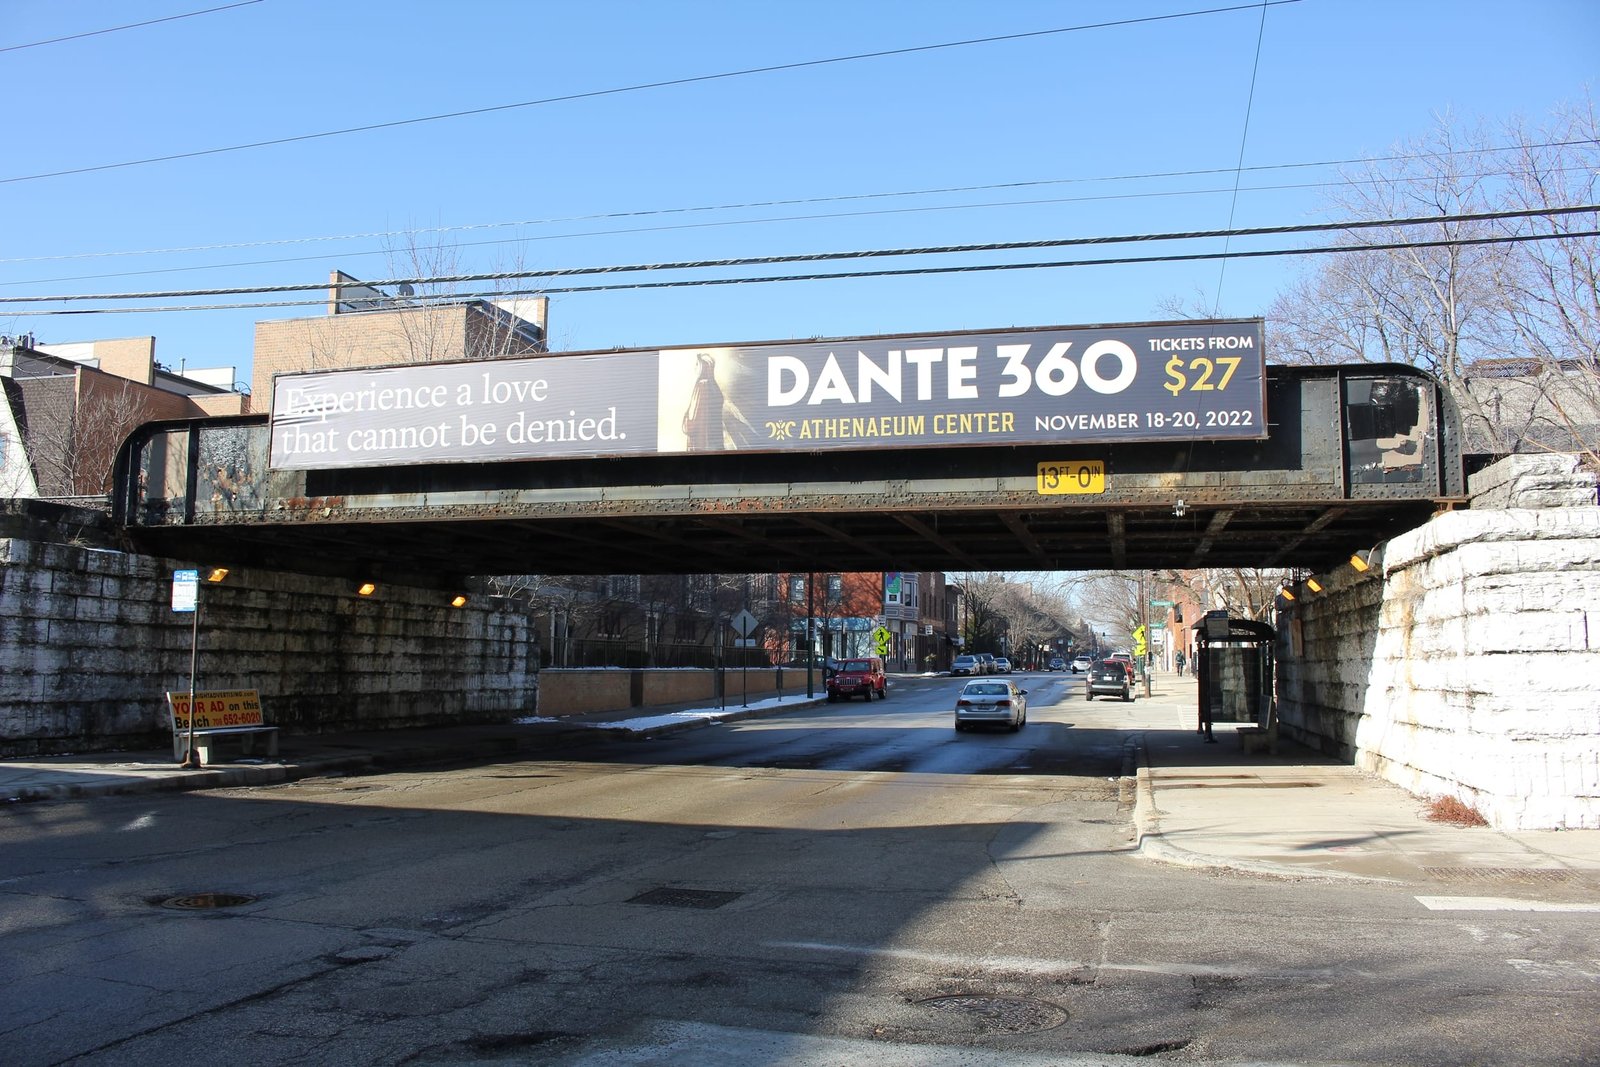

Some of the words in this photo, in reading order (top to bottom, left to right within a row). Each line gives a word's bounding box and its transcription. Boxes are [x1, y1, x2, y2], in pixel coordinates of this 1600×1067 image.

[1149, 338, 1205, 351] TICKETS
[1209, 336, 1253, 350] FROM
[767, 346, 978, 406] DANTE
[996, 339, 1137, 398] 360
[1163, 354, 1242, 397] $27
[285, 382, 448, 424] Experience
[457, 383, 473, 406] a
[481, 372, 549, 404] love
[281, 423, 339, 454] that
[347, 422, 451, 450] cannot
[459, 414, 497, 447] be
[506, 406, 627, 445] denied.
[799, 415, 926, 440] ATHENAEUM
[933, 411, 1015, 435] CENTER
[1035, 413, 1138, 431] NOVEMBER
[1145, 411, 1200, 430] 18-20,
[1205, 410, 1253, 427] 2022
[211, 701, 225, 712] AD
[229, 703, 240, 711] on
[243, 701, 259, 710] this
